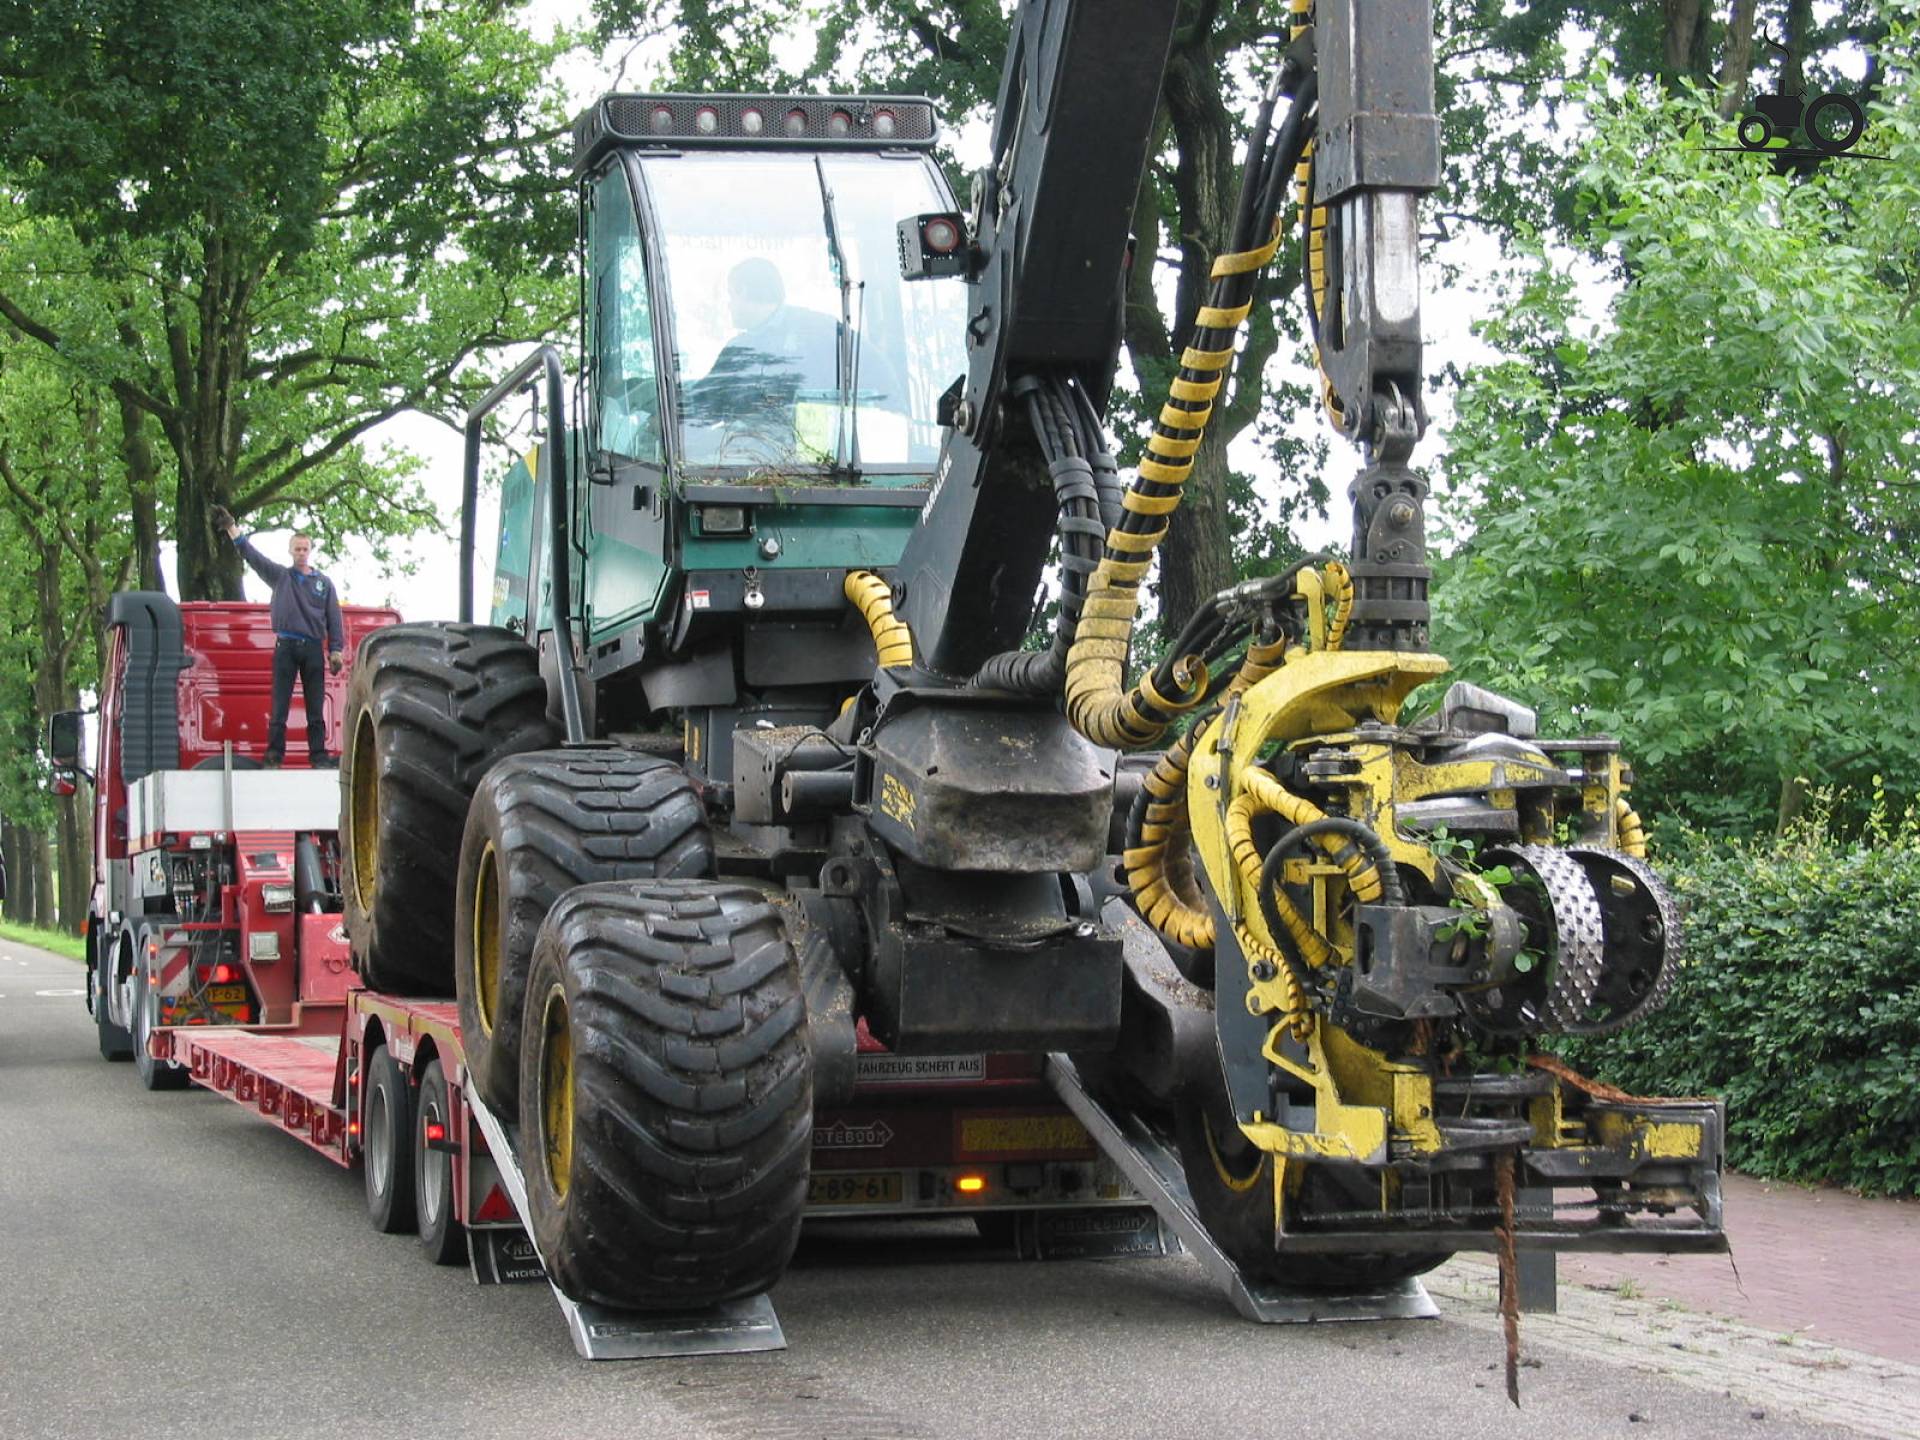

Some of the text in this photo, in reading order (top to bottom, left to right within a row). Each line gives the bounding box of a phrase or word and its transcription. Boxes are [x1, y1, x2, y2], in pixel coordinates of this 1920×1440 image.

[857, 1059, 980, 1074] FAHRZEUG SCHERT AUS
